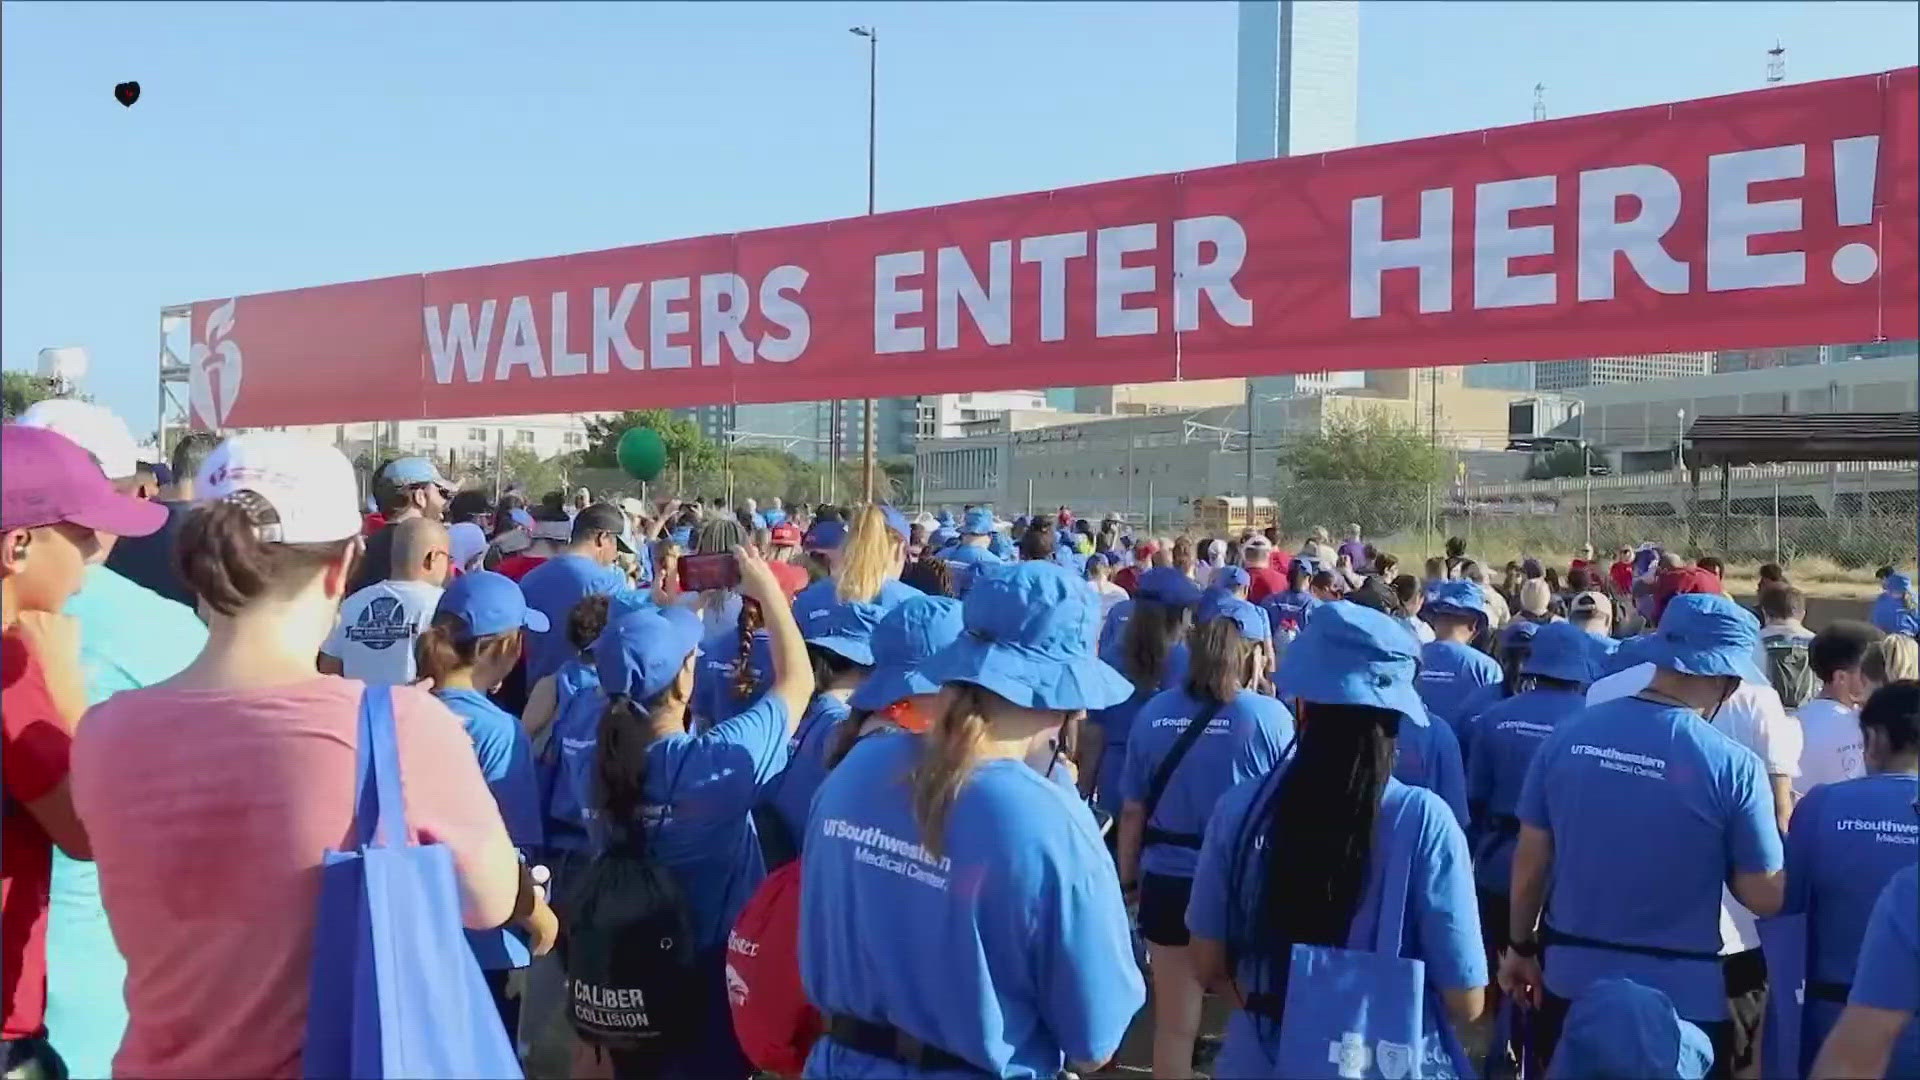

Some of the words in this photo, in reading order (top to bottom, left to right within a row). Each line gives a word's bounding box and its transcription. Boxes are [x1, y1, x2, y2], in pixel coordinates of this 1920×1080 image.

[423, 265, 811, 385] WALKERS
[874, 215, 1254, 354] ENTER
[1350, 135, 1880, 319] HERE!
[823, 819, 951, 872] UTSouthwesten
[854, 845, 907, 876] Medical
[574, 979, 645, 1009] CALIBER
[574, 1004, 649, 1028] COLLISION
